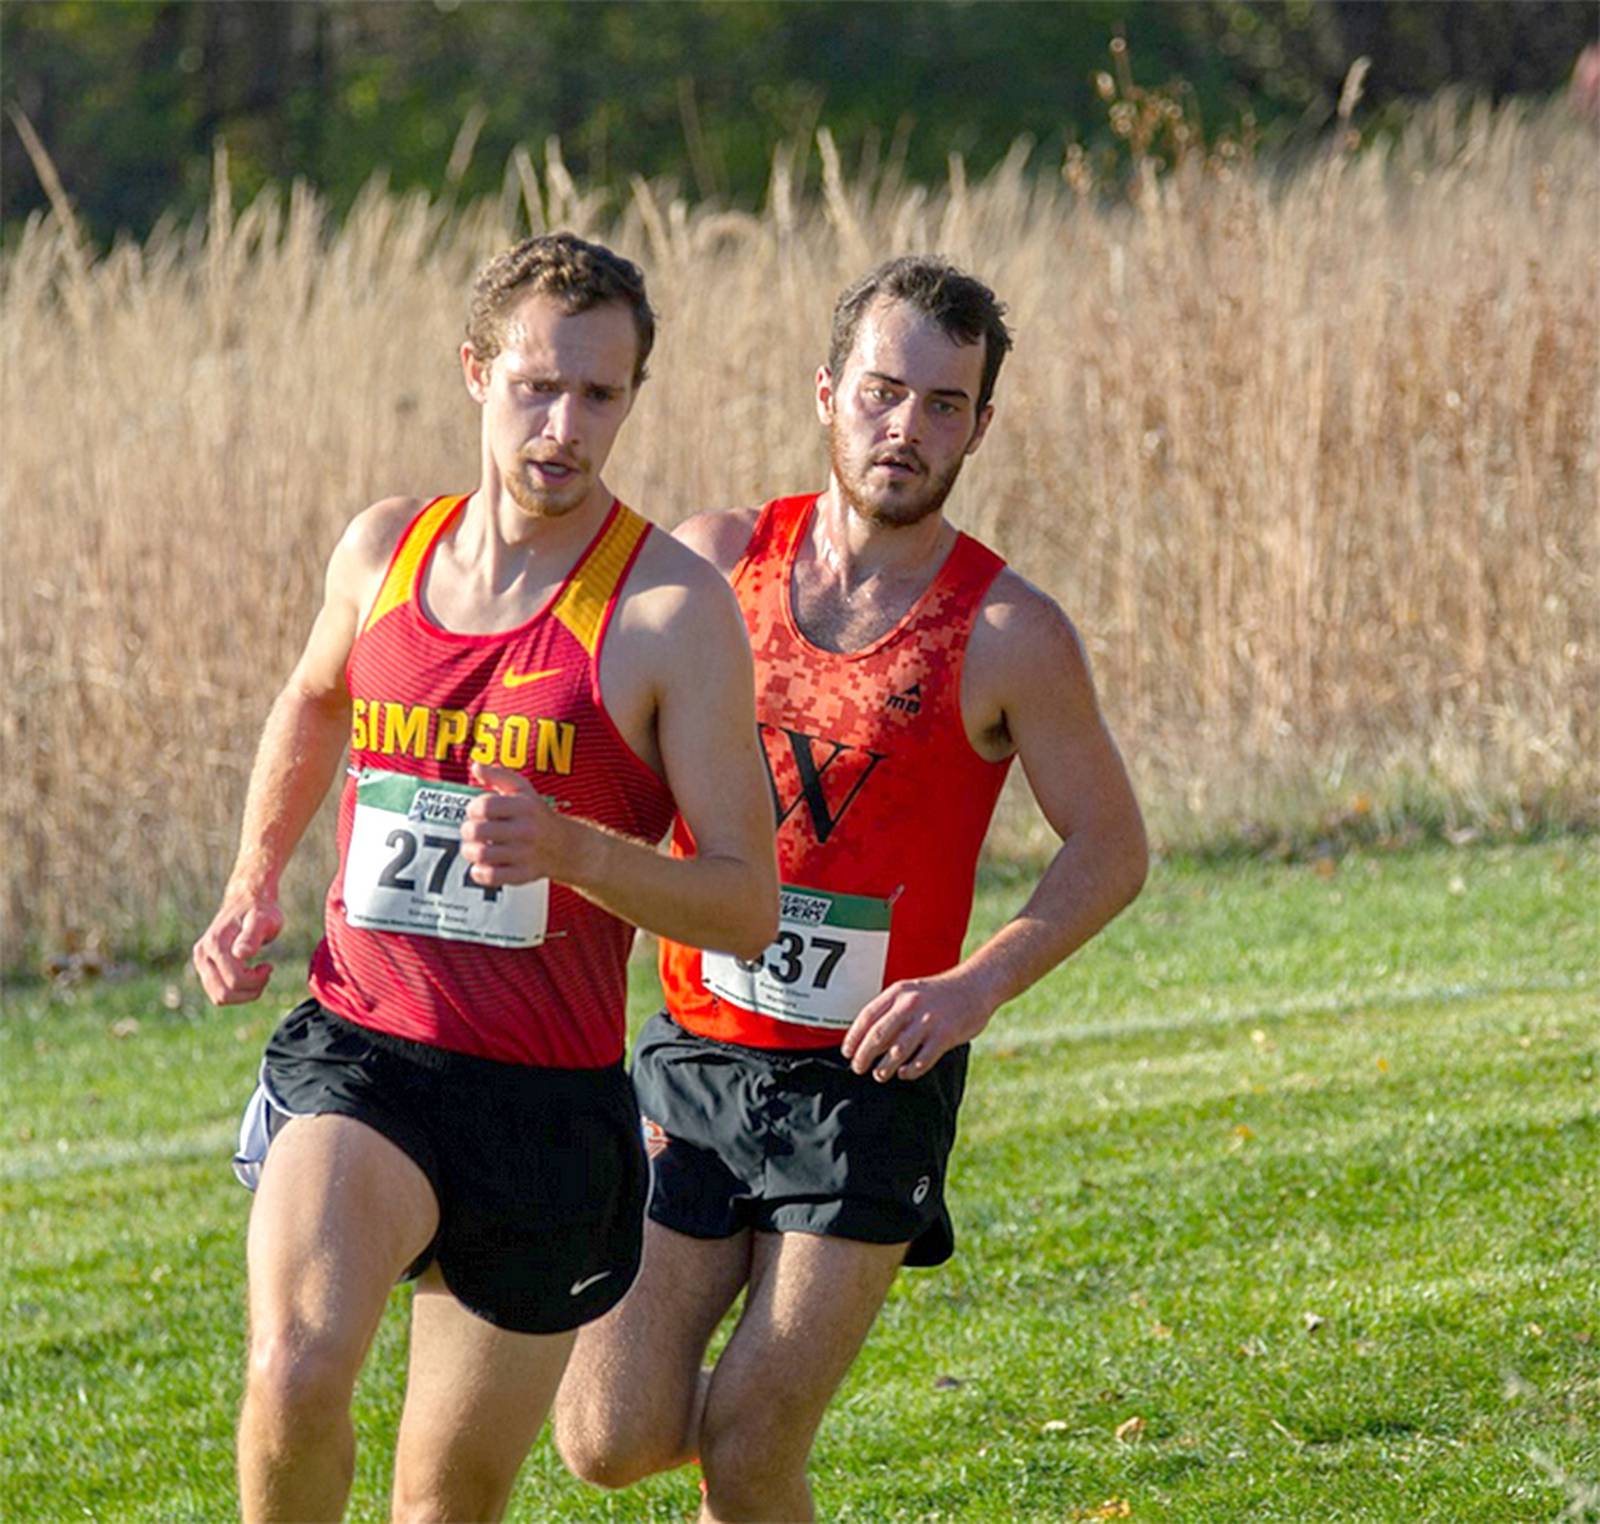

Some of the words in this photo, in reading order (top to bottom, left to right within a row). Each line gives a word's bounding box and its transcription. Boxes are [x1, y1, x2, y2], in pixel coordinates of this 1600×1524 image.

[351, 698, 576, 775] SIMPSON
[419, 790, 471, 806] AMERIC
[412, 801, 467, 821] RIVER
[782, 905, 823, 920] VERS
[735, 930, 848, 990] 37
